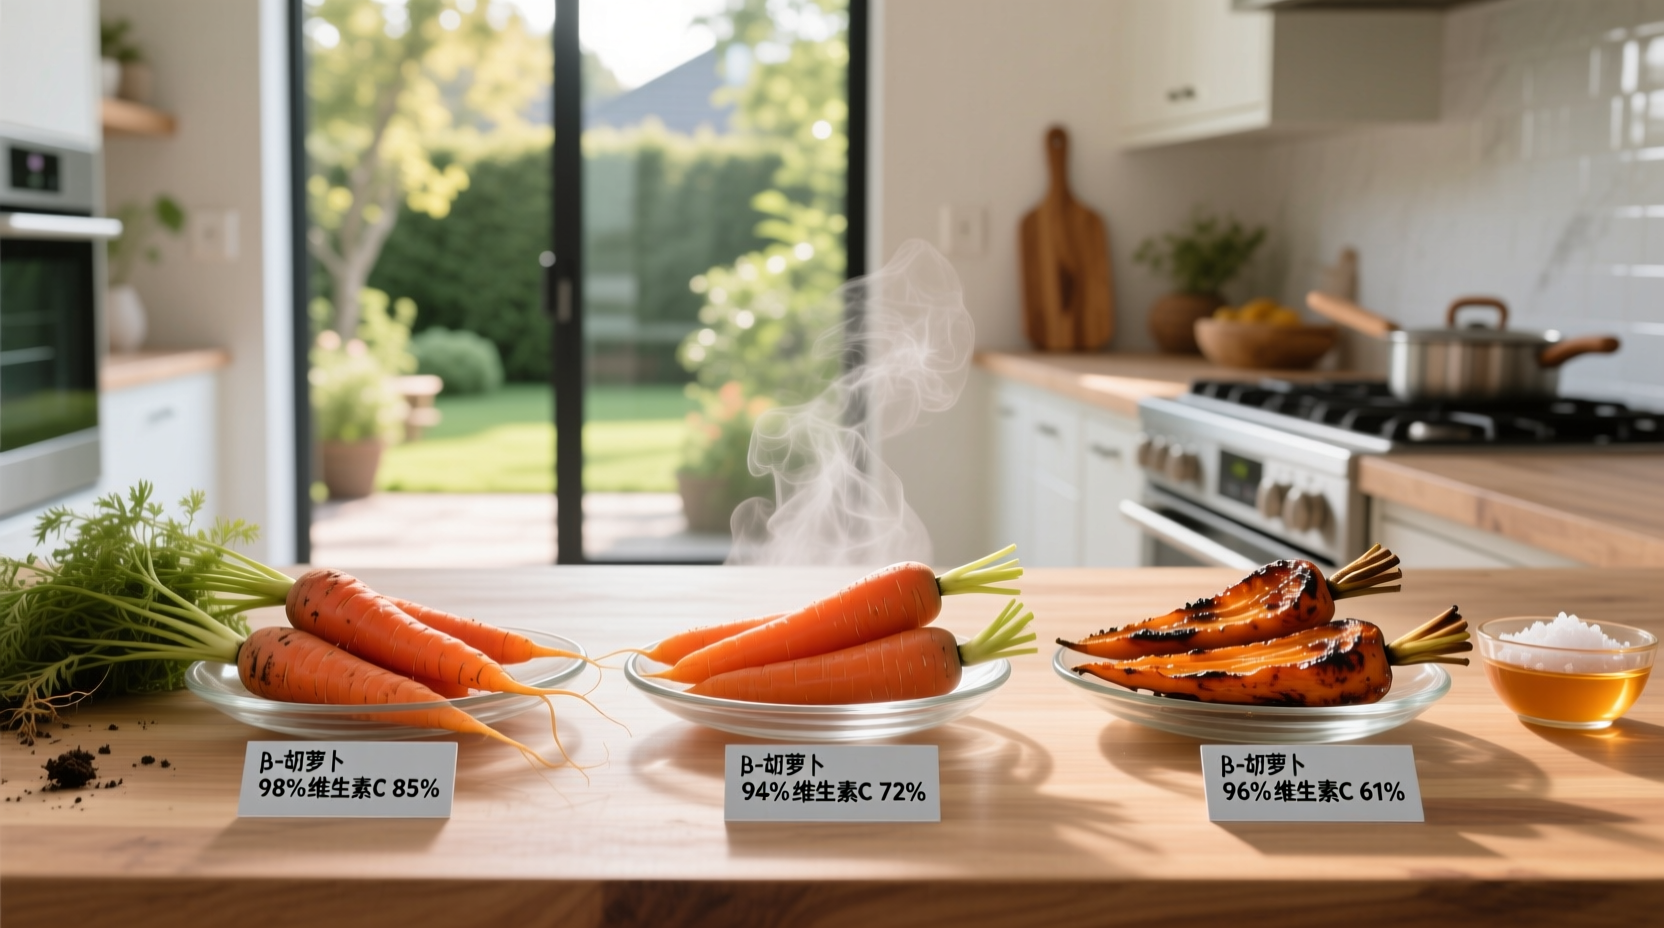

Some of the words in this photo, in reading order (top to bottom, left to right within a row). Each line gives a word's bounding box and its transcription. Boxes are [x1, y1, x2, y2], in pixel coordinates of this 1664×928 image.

[392, 778, 440, 799] 85%
[879, 781, 927, 802] 72%
[1359, 781, 1406, 802] 61%
